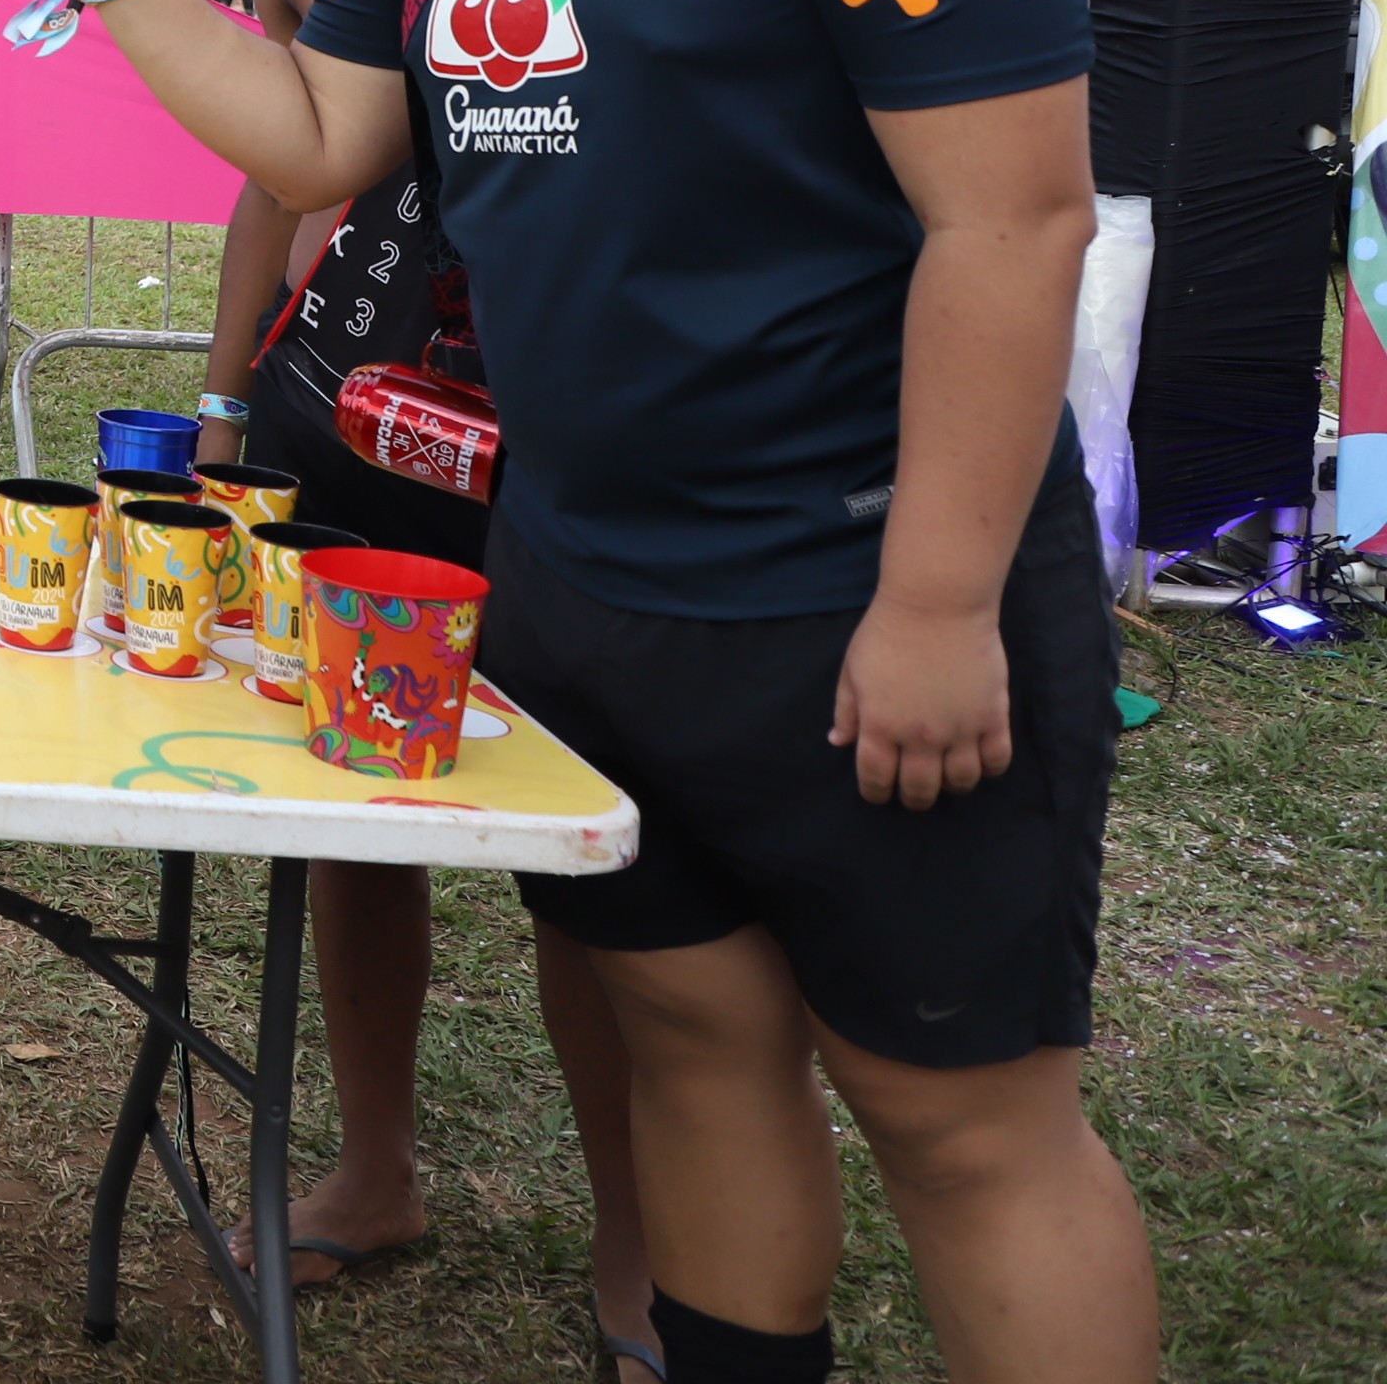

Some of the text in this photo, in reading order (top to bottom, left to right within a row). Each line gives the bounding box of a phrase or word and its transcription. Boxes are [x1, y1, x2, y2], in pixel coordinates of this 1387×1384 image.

[444, 84, 580, 153] Guaraná
[473, 133, 578, 154] ANTARCTICA
[376, 393, 404, 467] PUCCAMP
[392, 431, 412, 452] HC
[455, 427, 481, 491] DIREITO
[32, 588, 65, 604] 2024
[10, 602, 57, 620] CARNAVAL
[148, 611, 185, 627] 2024
[132, 628, 177, 646] CARNAVAL
